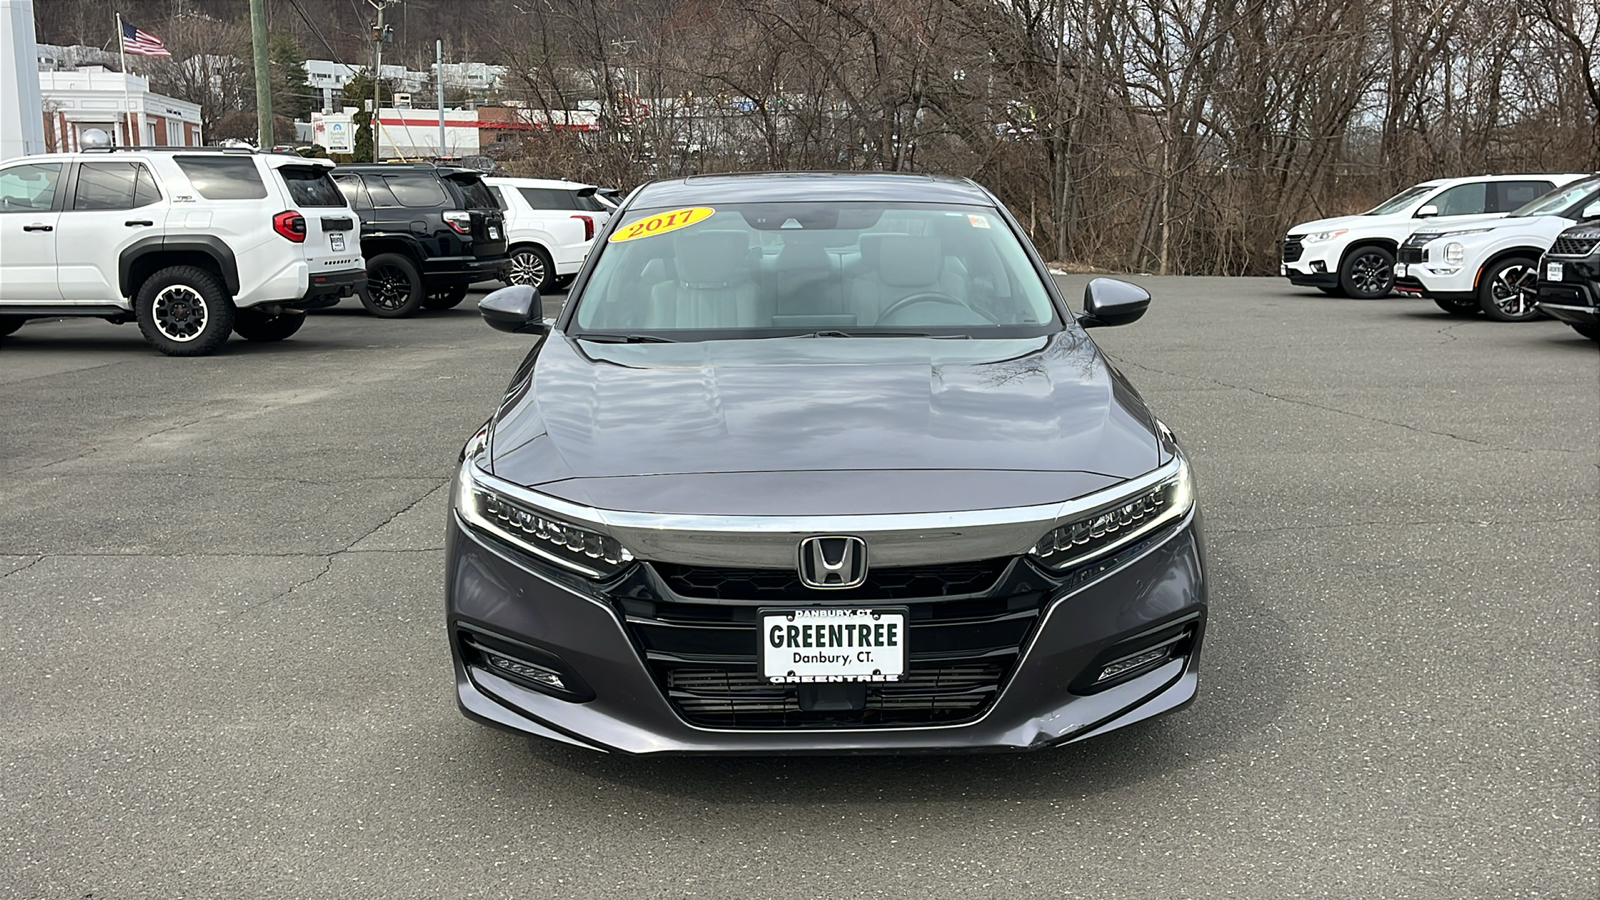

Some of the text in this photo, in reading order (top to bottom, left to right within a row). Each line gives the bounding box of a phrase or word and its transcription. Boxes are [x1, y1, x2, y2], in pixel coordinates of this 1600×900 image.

[628, 210, 693, 238] 2017
[795, 609, 872, 618] DANBURY, CT
[770, 623, 898, 648] GREENTREE
[793, 651, 874, 666] Danbury, CT.
[770, 675, 899, 683] GREENTREE
